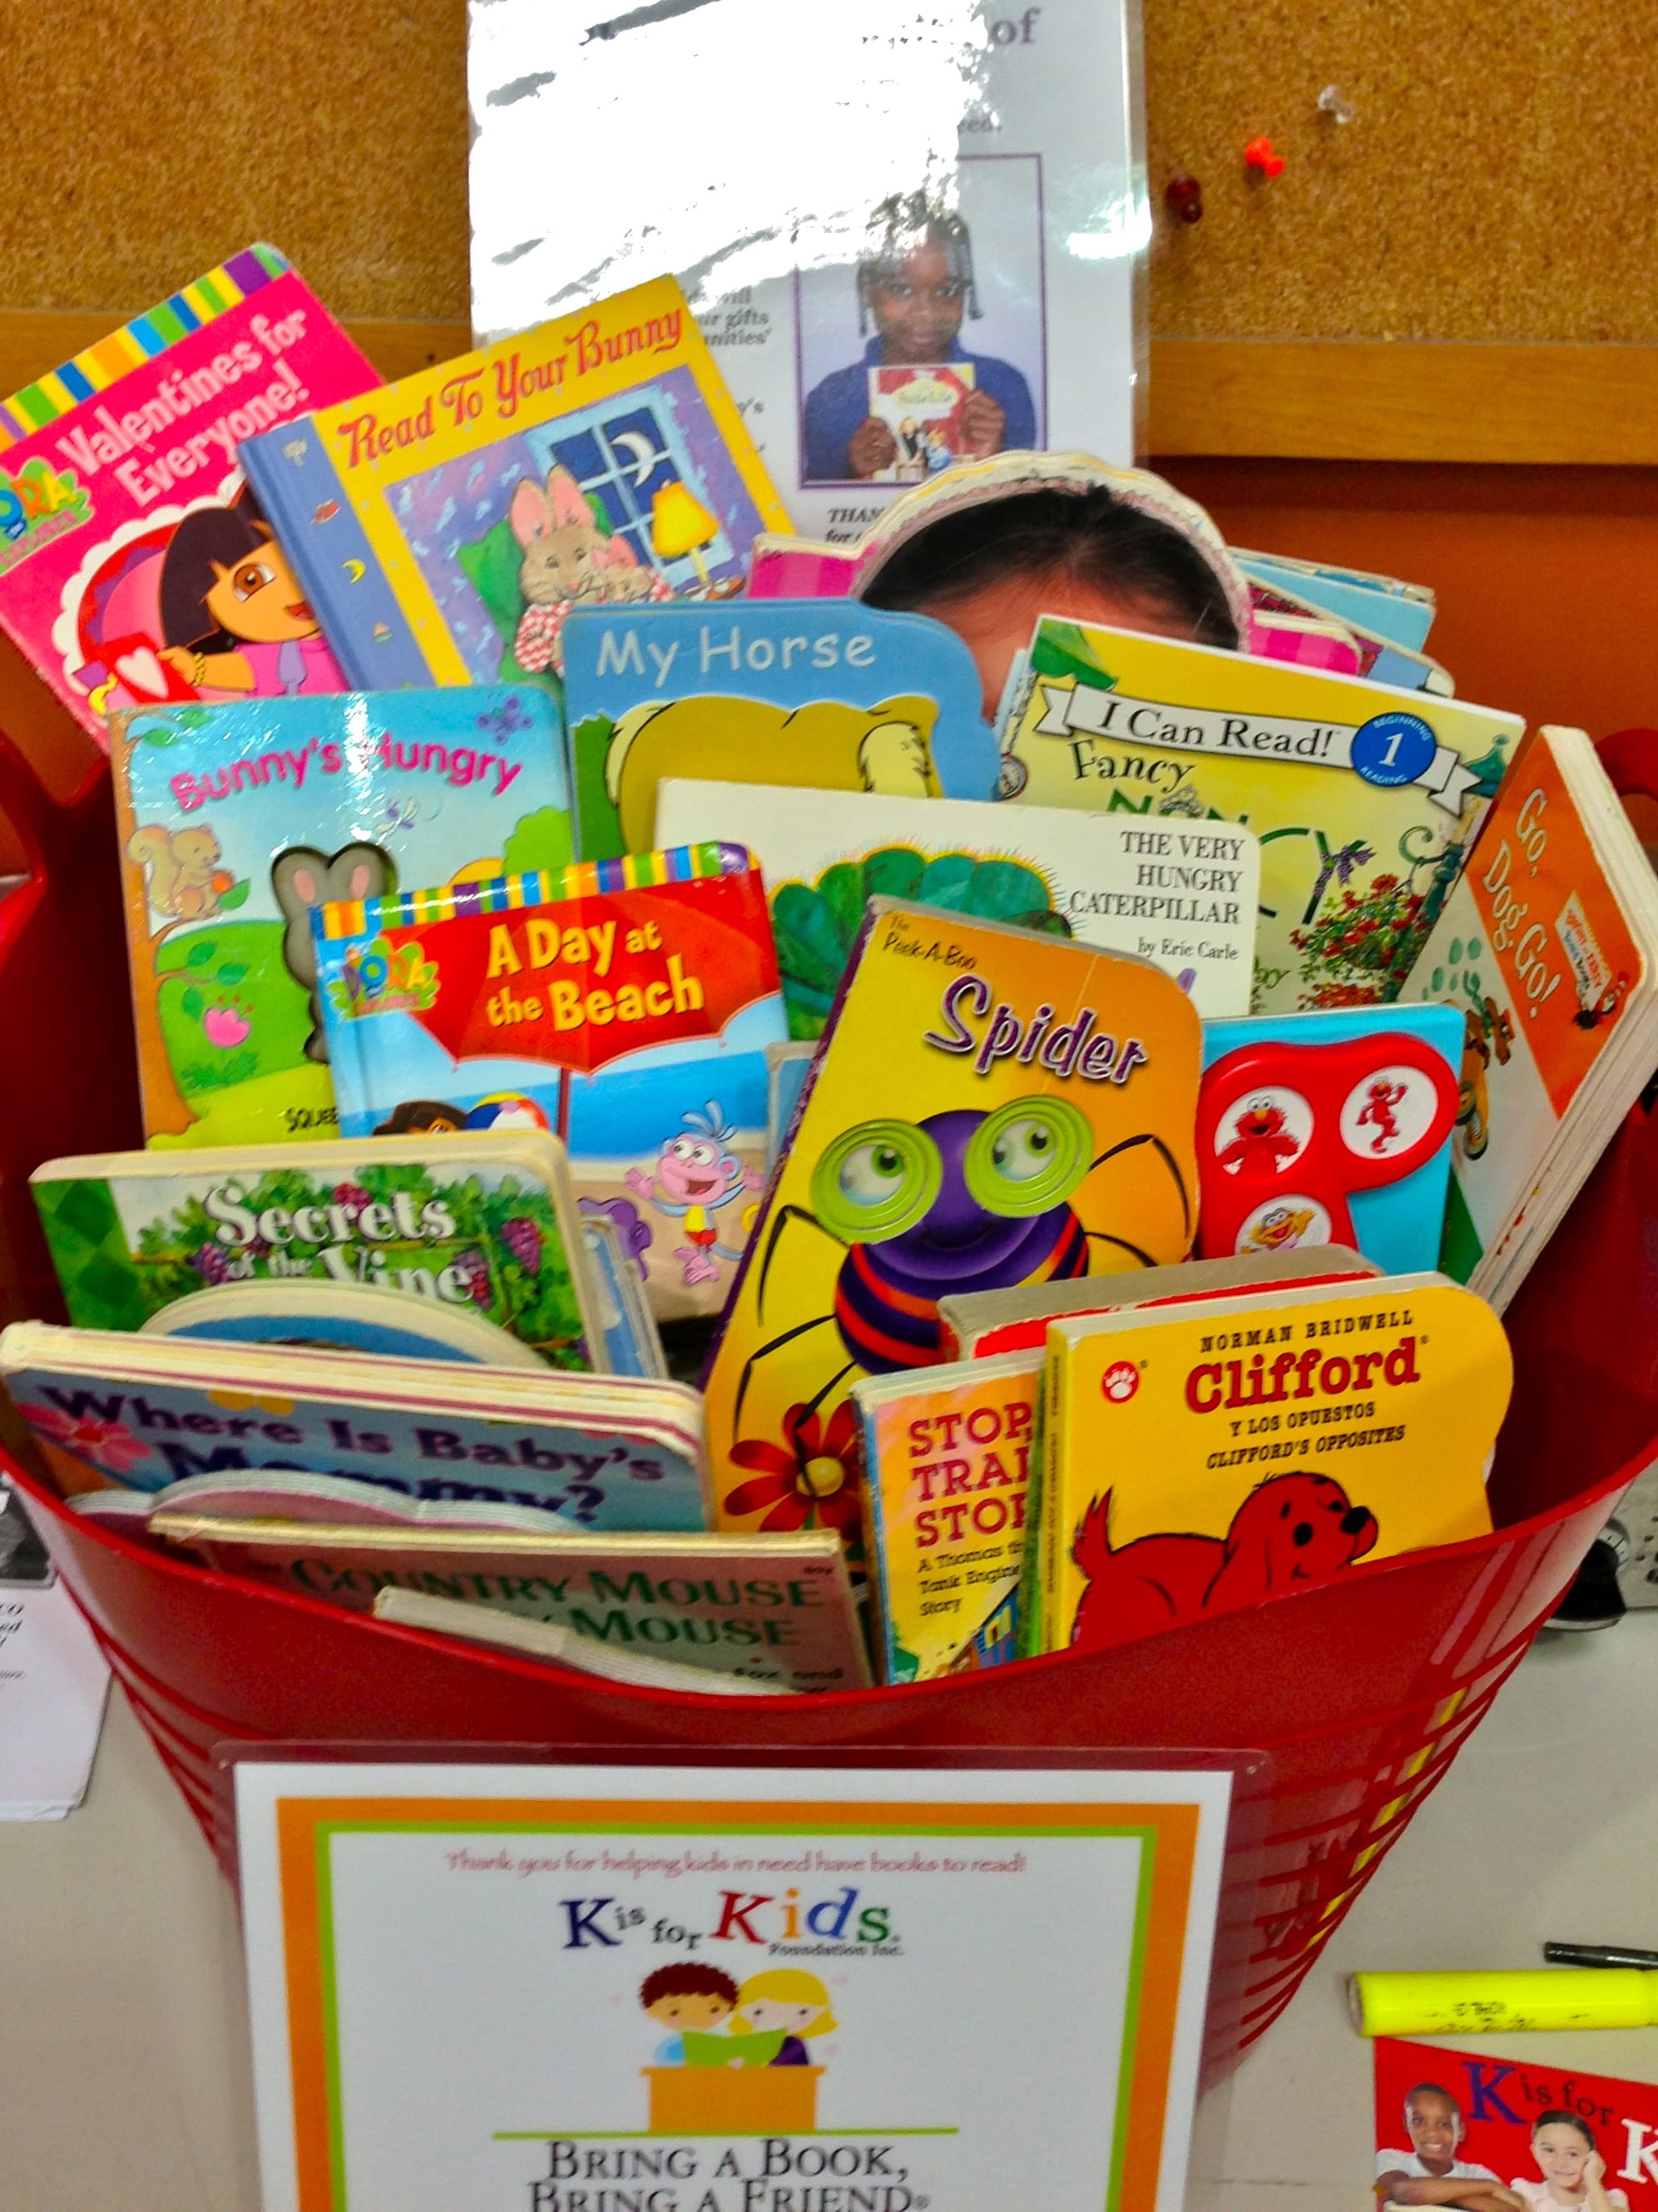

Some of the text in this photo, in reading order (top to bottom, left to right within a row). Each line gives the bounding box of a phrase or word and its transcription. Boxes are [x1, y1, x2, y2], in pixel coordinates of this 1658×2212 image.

[990, 6, 1042, 46] of
[725, 307, 770, 331] gifts
[56, 309, 308, 476] Valentines for
[337, 308, 683, 468] Read To Your Bunny
[114, 359, 310, 507] Everyone!
[595, 625, 877, 688] My Horse
[1096, 699, 1334, 759] I Can Read!
[1378, 732, 1404, 767] 1
[170, 732, 523, 813] Bunny's Hungry
[1067, 736, 1196, 794] Fancy
[1120, 830, 1246, 861] THE VERY
[1135, 864, 1245, 893] HUNGRY
[1069, 890, 1240, 926] CATERPILLAR
[487, 917, 663, 979] A Day at
[1137, 936, 1240, 961] by Eric Carle
[1514, 923, 1561, 1019] Go!
[486, 986, 545, 1028] the
[549, 952, 705, 1032] Beach
[923, 972, 1150, 1084] Spider
[202, 1185, 458, 1247] Secrets
[228, 1245, 475, 1304] of the Vine
[1200, 1309, 1413, 1353] NORMAN BRIDWELL
[1185, 1335, 1420, 1414] Clifford
[36, 1383, 666, 1482] Where Is Baby's
[1230, 1401, 1376, 1438] Y LOS OPUESTOS
[1206, 1424, 1407, 1470] CLIFFORD'S OPPOSITES
[917, 1558, 933, 1574] A
[935, 1544, 1003, 1567] Thomas
[918, 1562, 1021, 1595] Tank Engine
[588, 1570, 826, 1608] MOUSE
[918, 1597, 963, 1618] Story
[568, 1608, 800, 1646] MOUSE
[444, 1847, 514, 1871] Thank
[517, 1857, 562, 1879] you
[564, 1848, 598, 1871] for
[600, 1848, 682, 1880] helping
[682, 1848, 730, 1872] kids
[733, 1855, 755, 1872] in
[756, 1849, 813, 1872] need
[814, 1848, 867, 1872] have
[870, 1848, 939, 1872] books
[942, 1855, 968, 1872] to
[558, 1896, 624, 1950] K
[614, 1905, 647, 1930] is
[651, 1916, 704, 1951] for
[768, 1941, 868, 1956] Foundation
[1460, 2060, 1615, 2127] K is for
[546, 2136, 910, 2185] BRING A BOOK,
[527, 2178, 679, 2212] BRING
[696, 2187, 723, 2212] A
